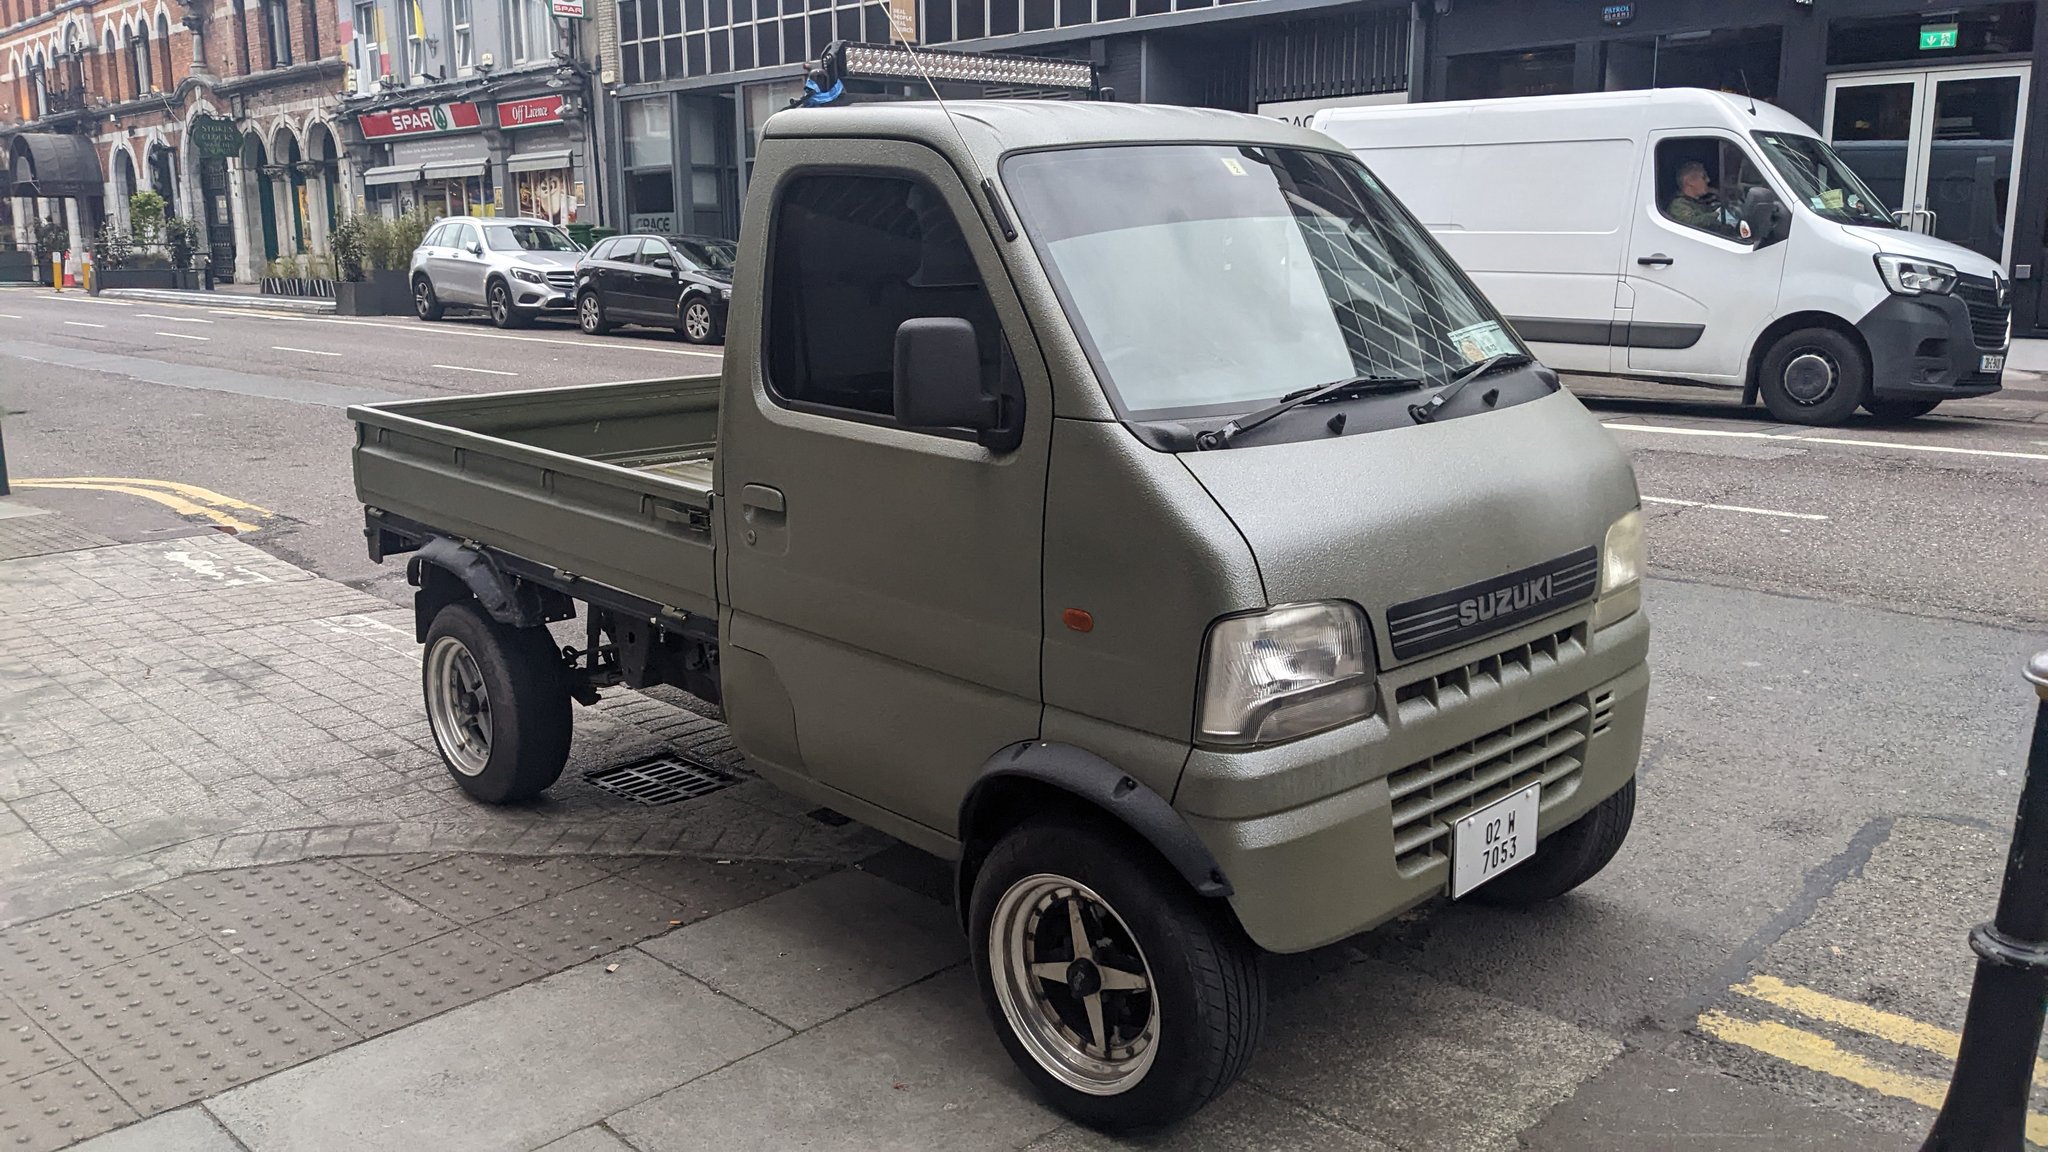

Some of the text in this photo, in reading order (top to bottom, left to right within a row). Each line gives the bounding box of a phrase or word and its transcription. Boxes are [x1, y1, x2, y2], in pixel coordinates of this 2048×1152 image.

[554, 5, 582, 13] SPAR
[391, 112, 433, 131] SPAR
[511, 104, 548, 124] Off Licence
[635, 217, 671, 232] GRACE
[1459, 575, 1552, 627] SUZUKI
[1486, 818, 1501, 845] 02
[1482, 835, 1517, 875] 7053
